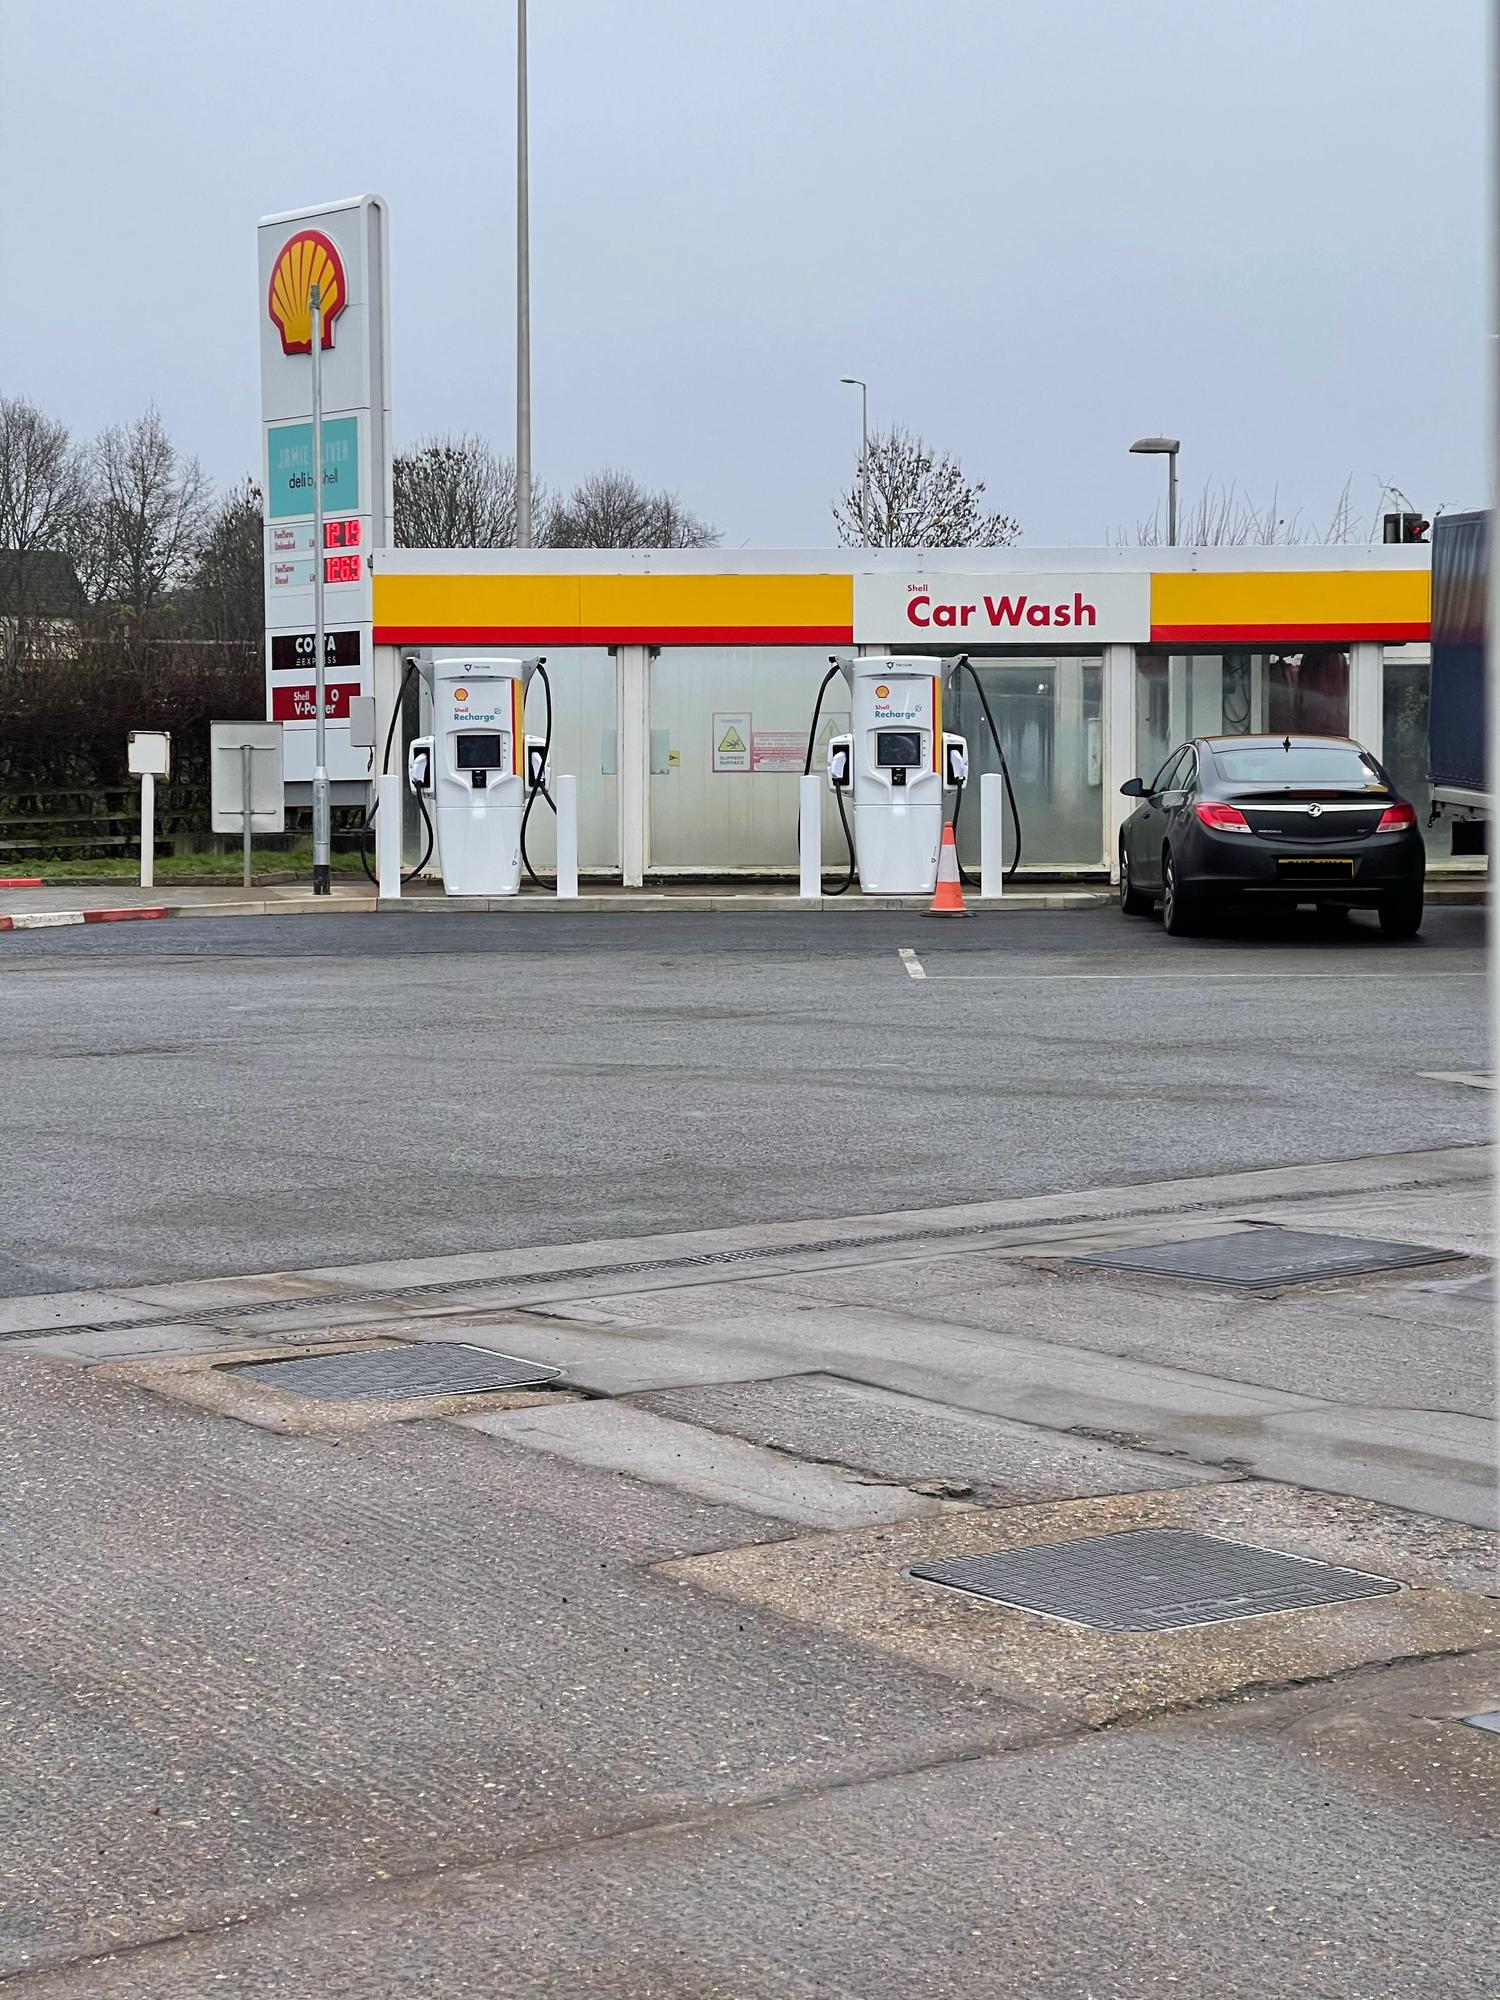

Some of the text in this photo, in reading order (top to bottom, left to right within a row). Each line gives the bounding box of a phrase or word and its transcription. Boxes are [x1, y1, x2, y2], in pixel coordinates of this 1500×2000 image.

[277, 445, 309, 470] JAMIE
[288, 472, 306, 489] deli
[907, 584, 928, 592] Shell
[907, 592, 1096, 627] Car Wash
[295, 635, 336, 653] COA
[293, 690, 310, 701] Shell
[294, 701, 336, 716] V-Poer
[875, 710, 916, 720] Recharge
[454, 713, 495, 723] Recharge
